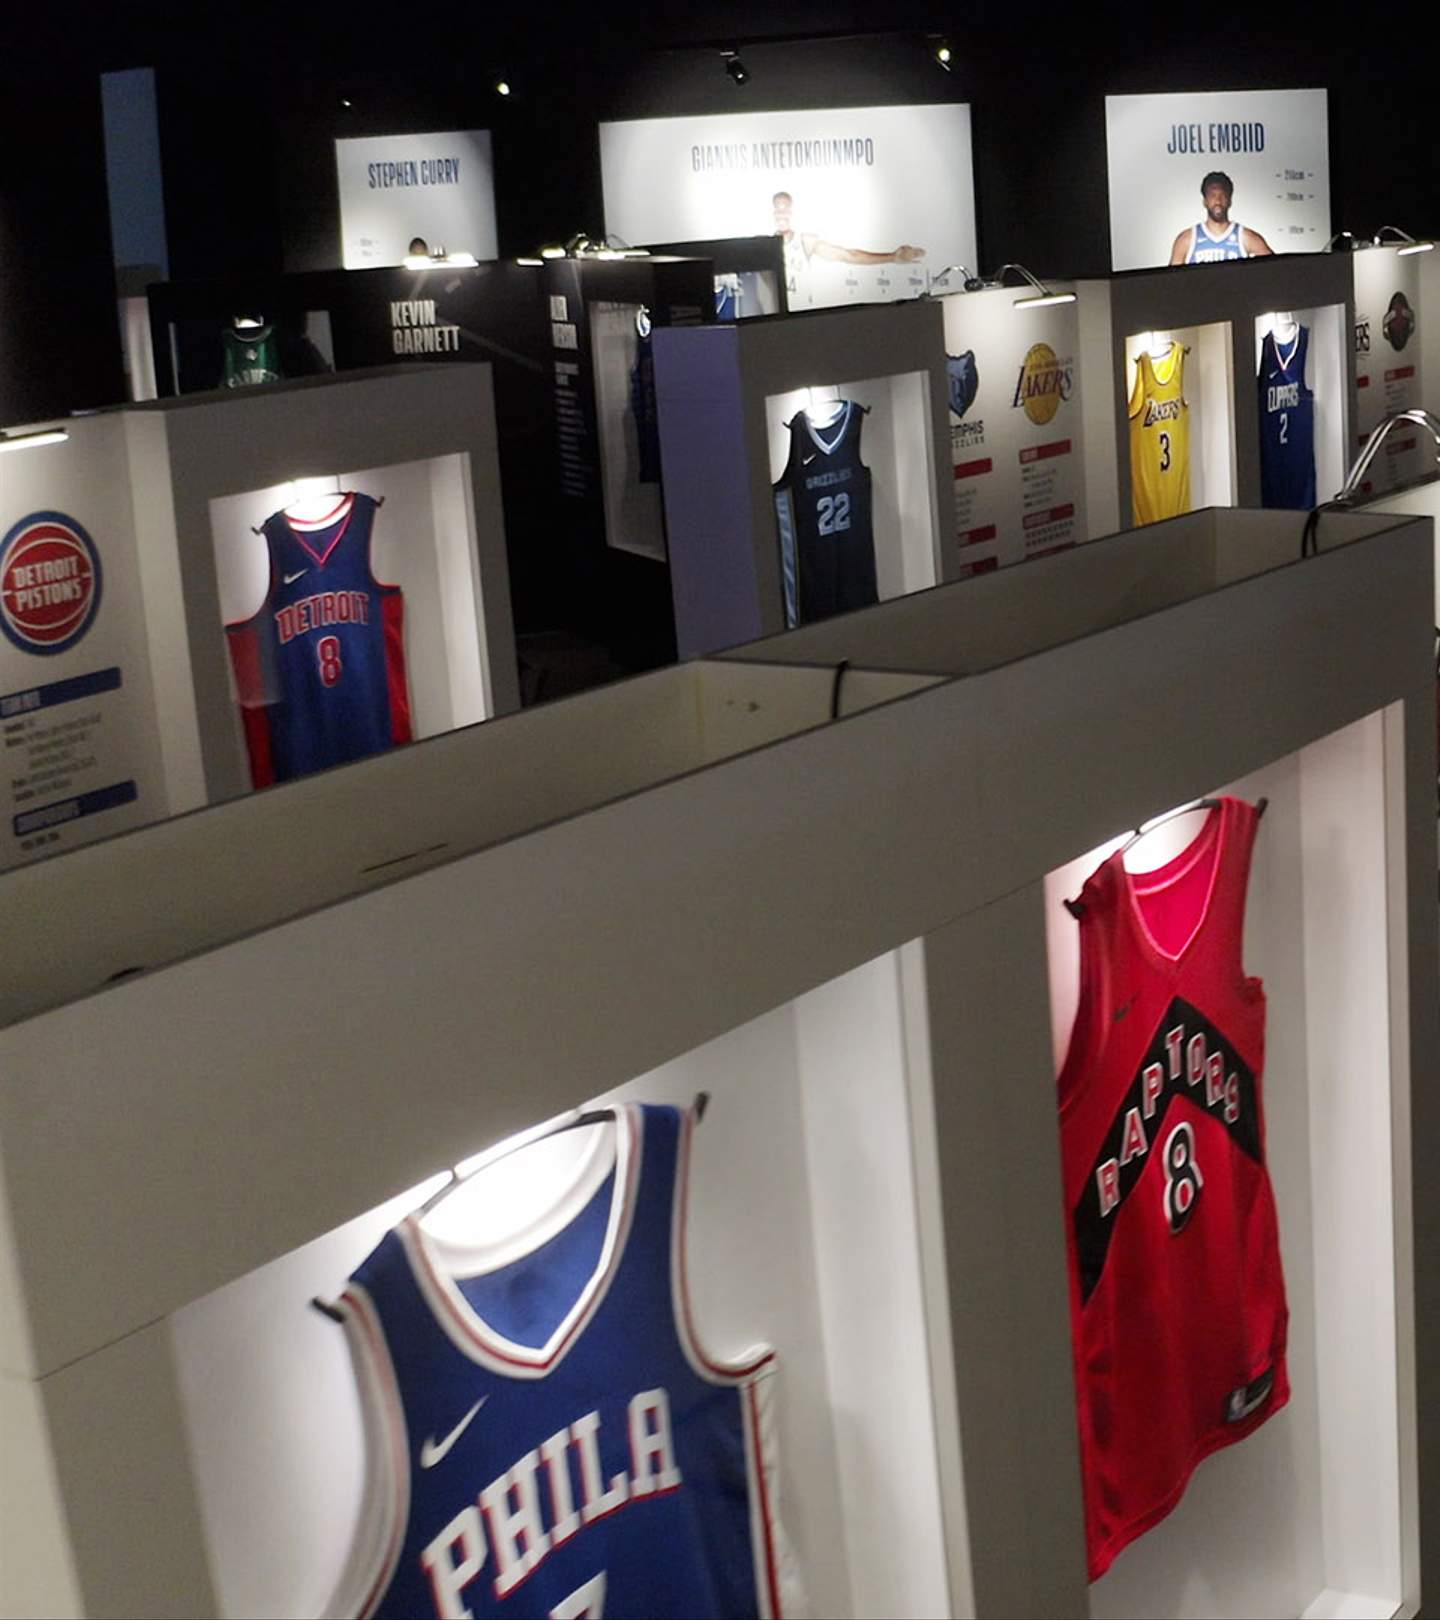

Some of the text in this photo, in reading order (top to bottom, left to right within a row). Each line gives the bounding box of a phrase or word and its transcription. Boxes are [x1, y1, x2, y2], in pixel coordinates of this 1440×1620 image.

[691, 137, 874, 172] GIANNIS ANTETOKOUNMPO
[1167, 122, 1265, 154] JOEL EMBIID
[368, 158, 460, 189] STEPHEN CURRY
[391, 300, 436, 327] KEVIN
[393, 325, 460, 354] GARNETT
[1267, 382, 1299, 413] CLIPPERS
[1279, 413, 1288, 444] 2
[1159, 432, 1171, 472] 3
[816, 492, 851, 536] 22
[12, 555, 79, 589] DETROIT
[15, 578, 82, 612] PISTONS
[274, 590, 370, 645] DETROIT
[316, 635, 342, 688] 8
[1096, 1023, 1241, 1219] RAPTORS
[1162, 1120, 1204, 1234] 8
[420, 1386, 684, 1620] PHILA
